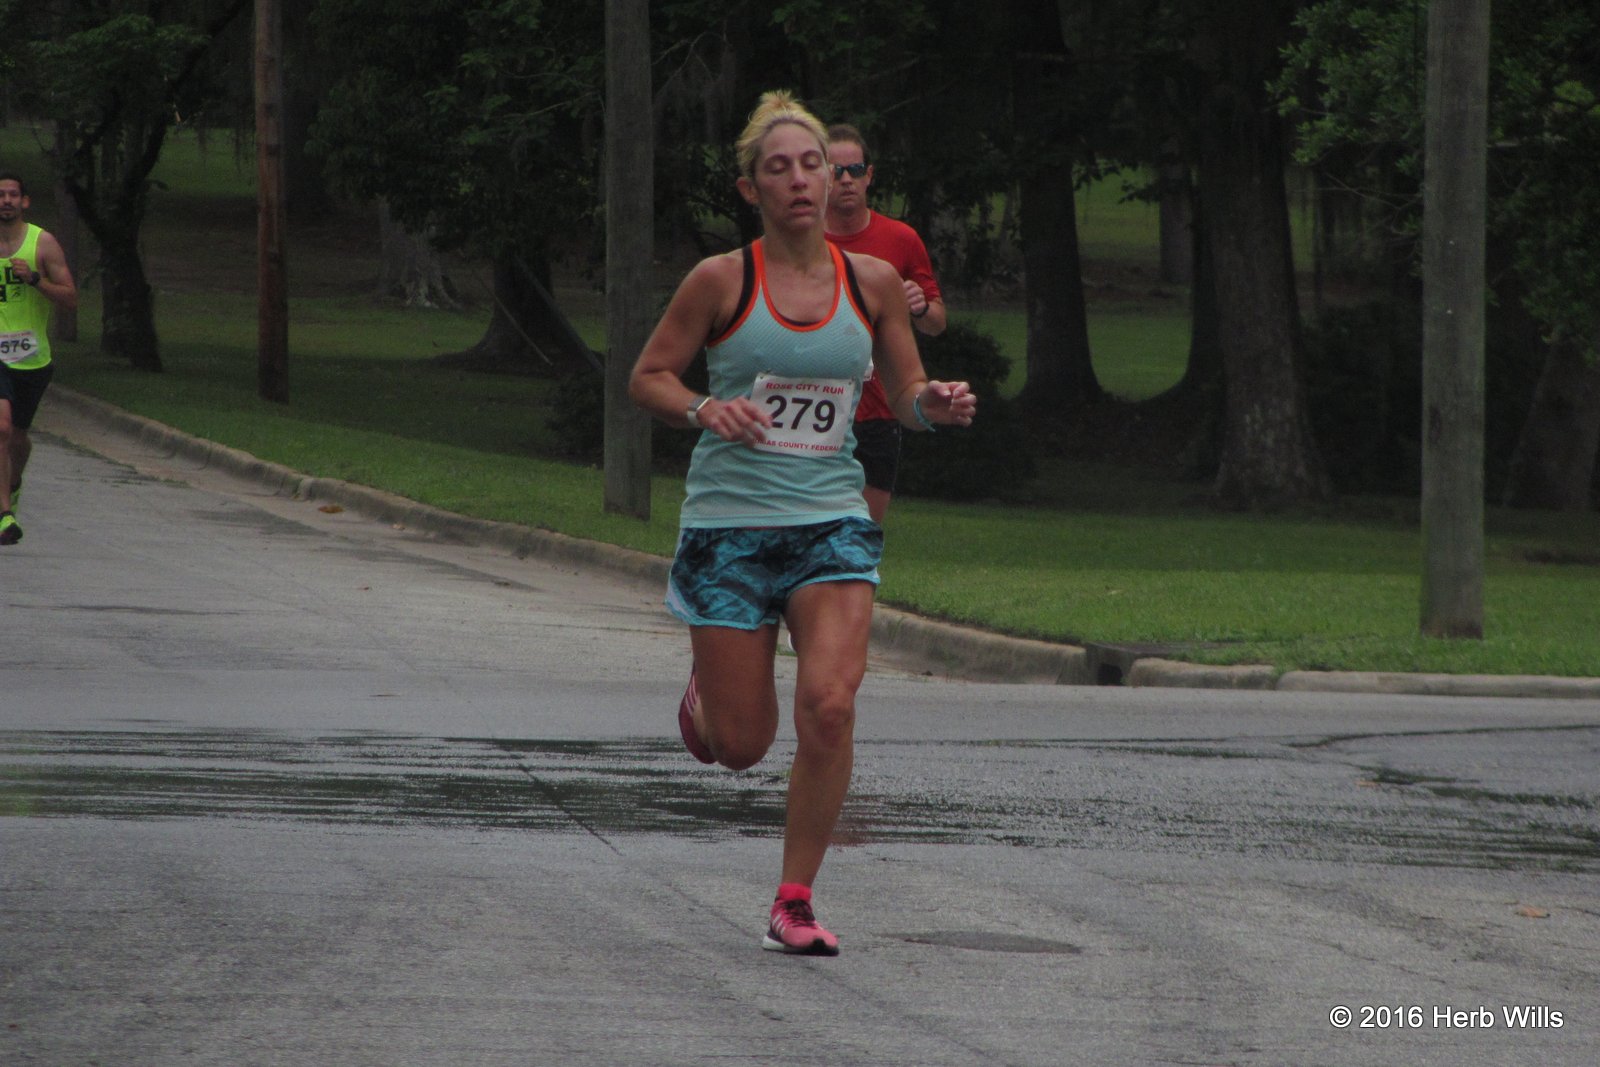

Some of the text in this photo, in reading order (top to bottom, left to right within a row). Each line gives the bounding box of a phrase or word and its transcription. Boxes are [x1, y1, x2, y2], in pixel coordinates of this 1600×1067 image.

[0, 338, 31, 354] 576
[766, 382, 844, 395] ROSE CITY RUN
[766, 395, 836, 433] 279
[779, 441, 809, 450] COUNTY
